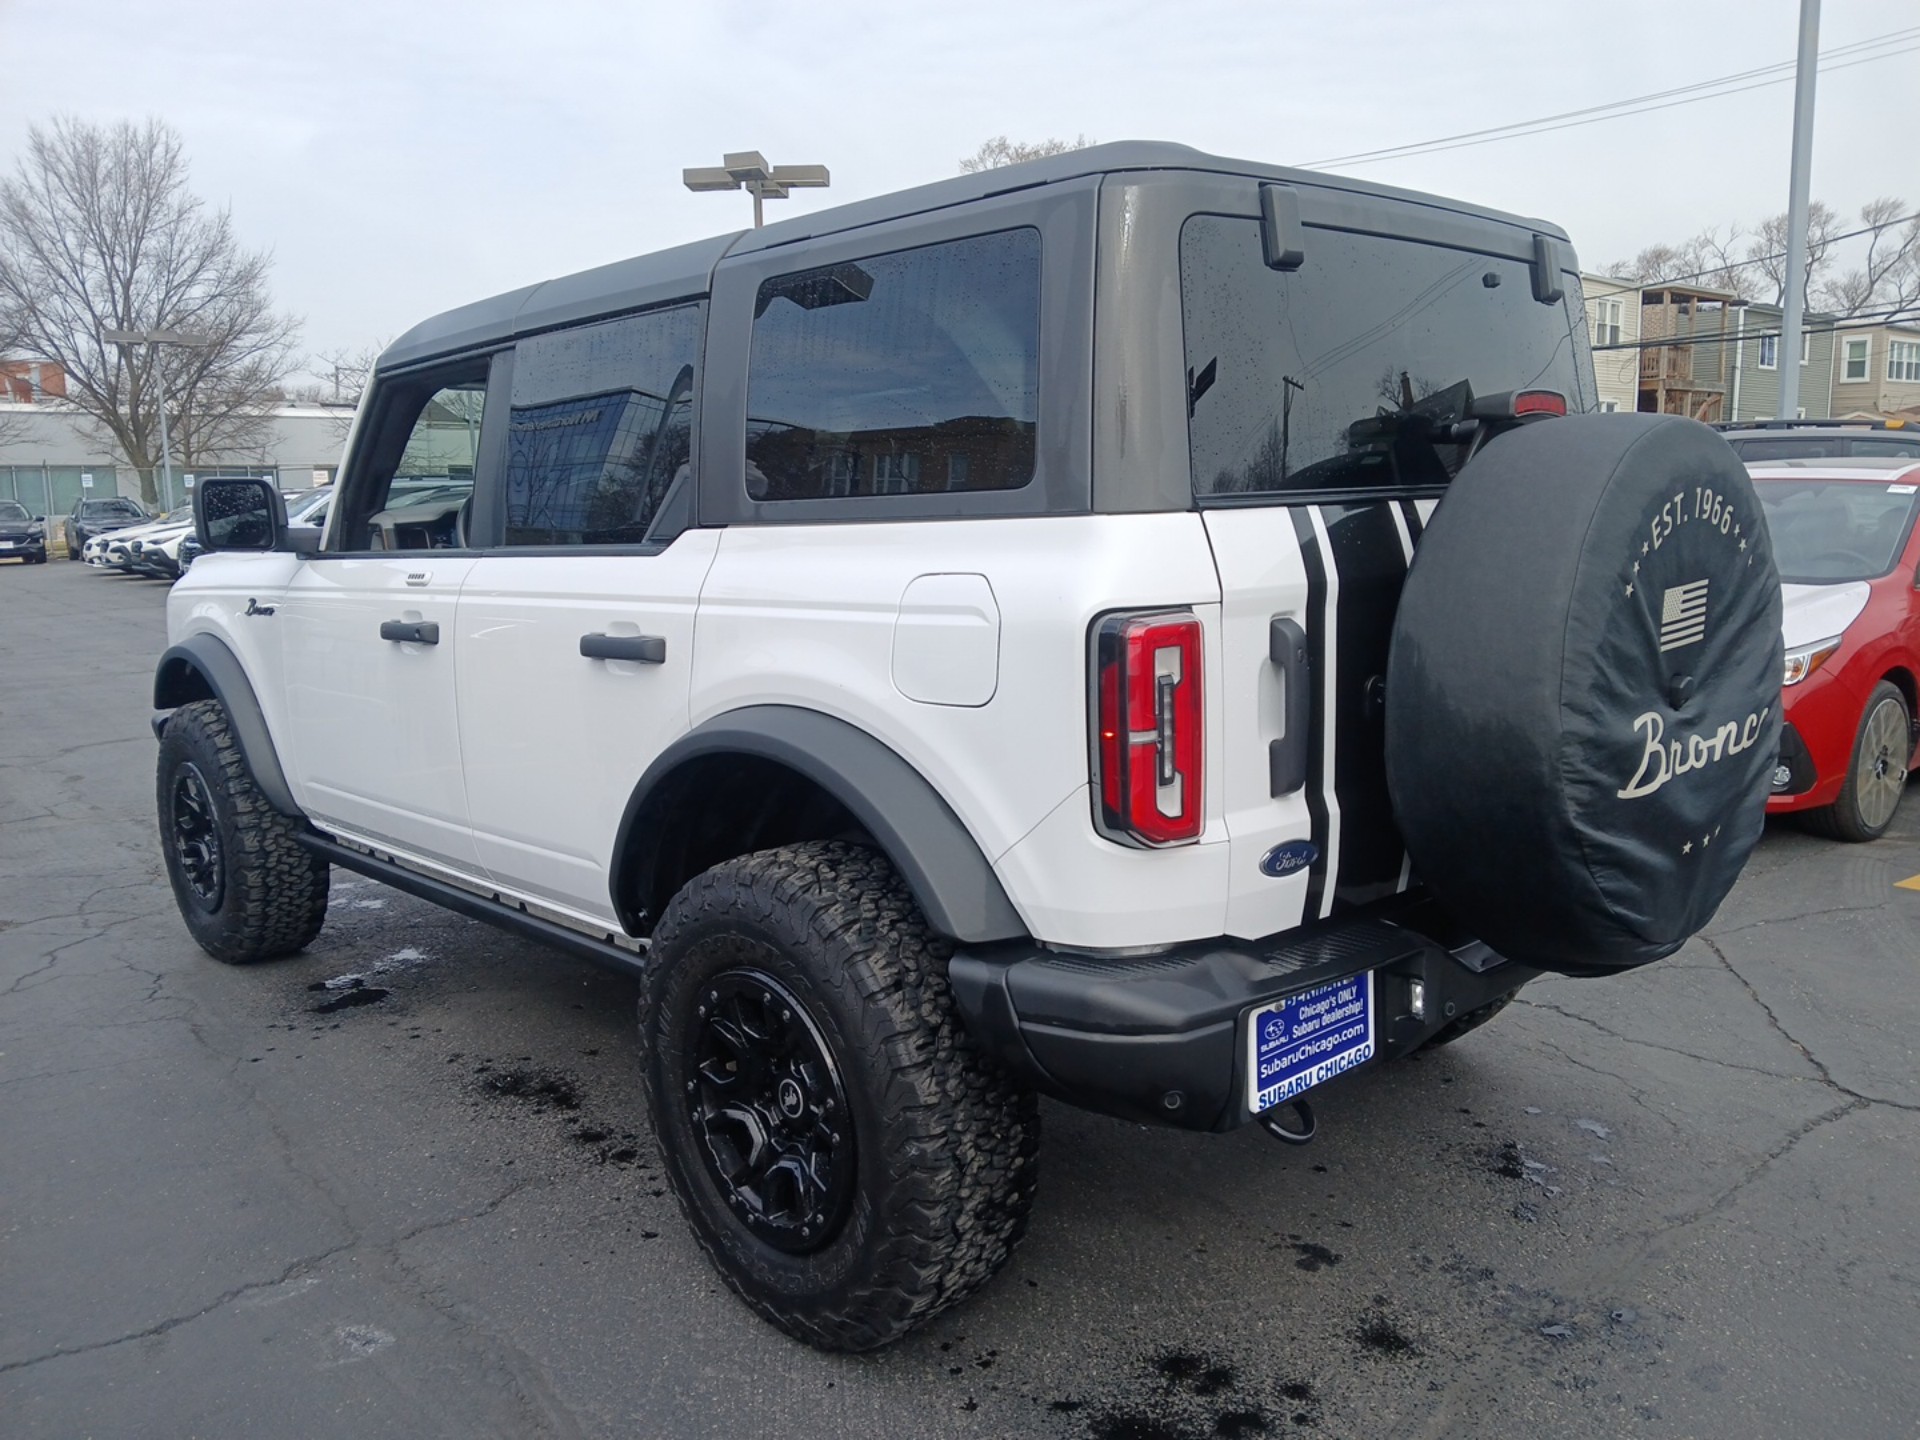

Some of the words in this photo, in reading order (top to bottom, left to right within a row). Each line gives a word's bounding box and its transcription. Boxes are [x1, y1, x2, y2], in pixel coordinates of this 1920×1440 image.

[1651, 492, 1688, 551] EST.
[1695, 487, 1734, 535] 1966
[1617, 707, 1769, 799] Bronc
[1292, 1018, 1321, 1039] Subaru
[1322, 998, 1364, 1026] dealership!
[1299, 995, 1337, 1021] Chicago's
[1338, 985, 1358, 1004] ONLY
[1260, 1034, 1289, 1053] SUBARU
[1260, 1023, 1365, 1078] SubaruChicago.com
[1258, 1072, 1313, 1110] SUBARU
[1316, 1043, 1372, 1082] CHICAGO
